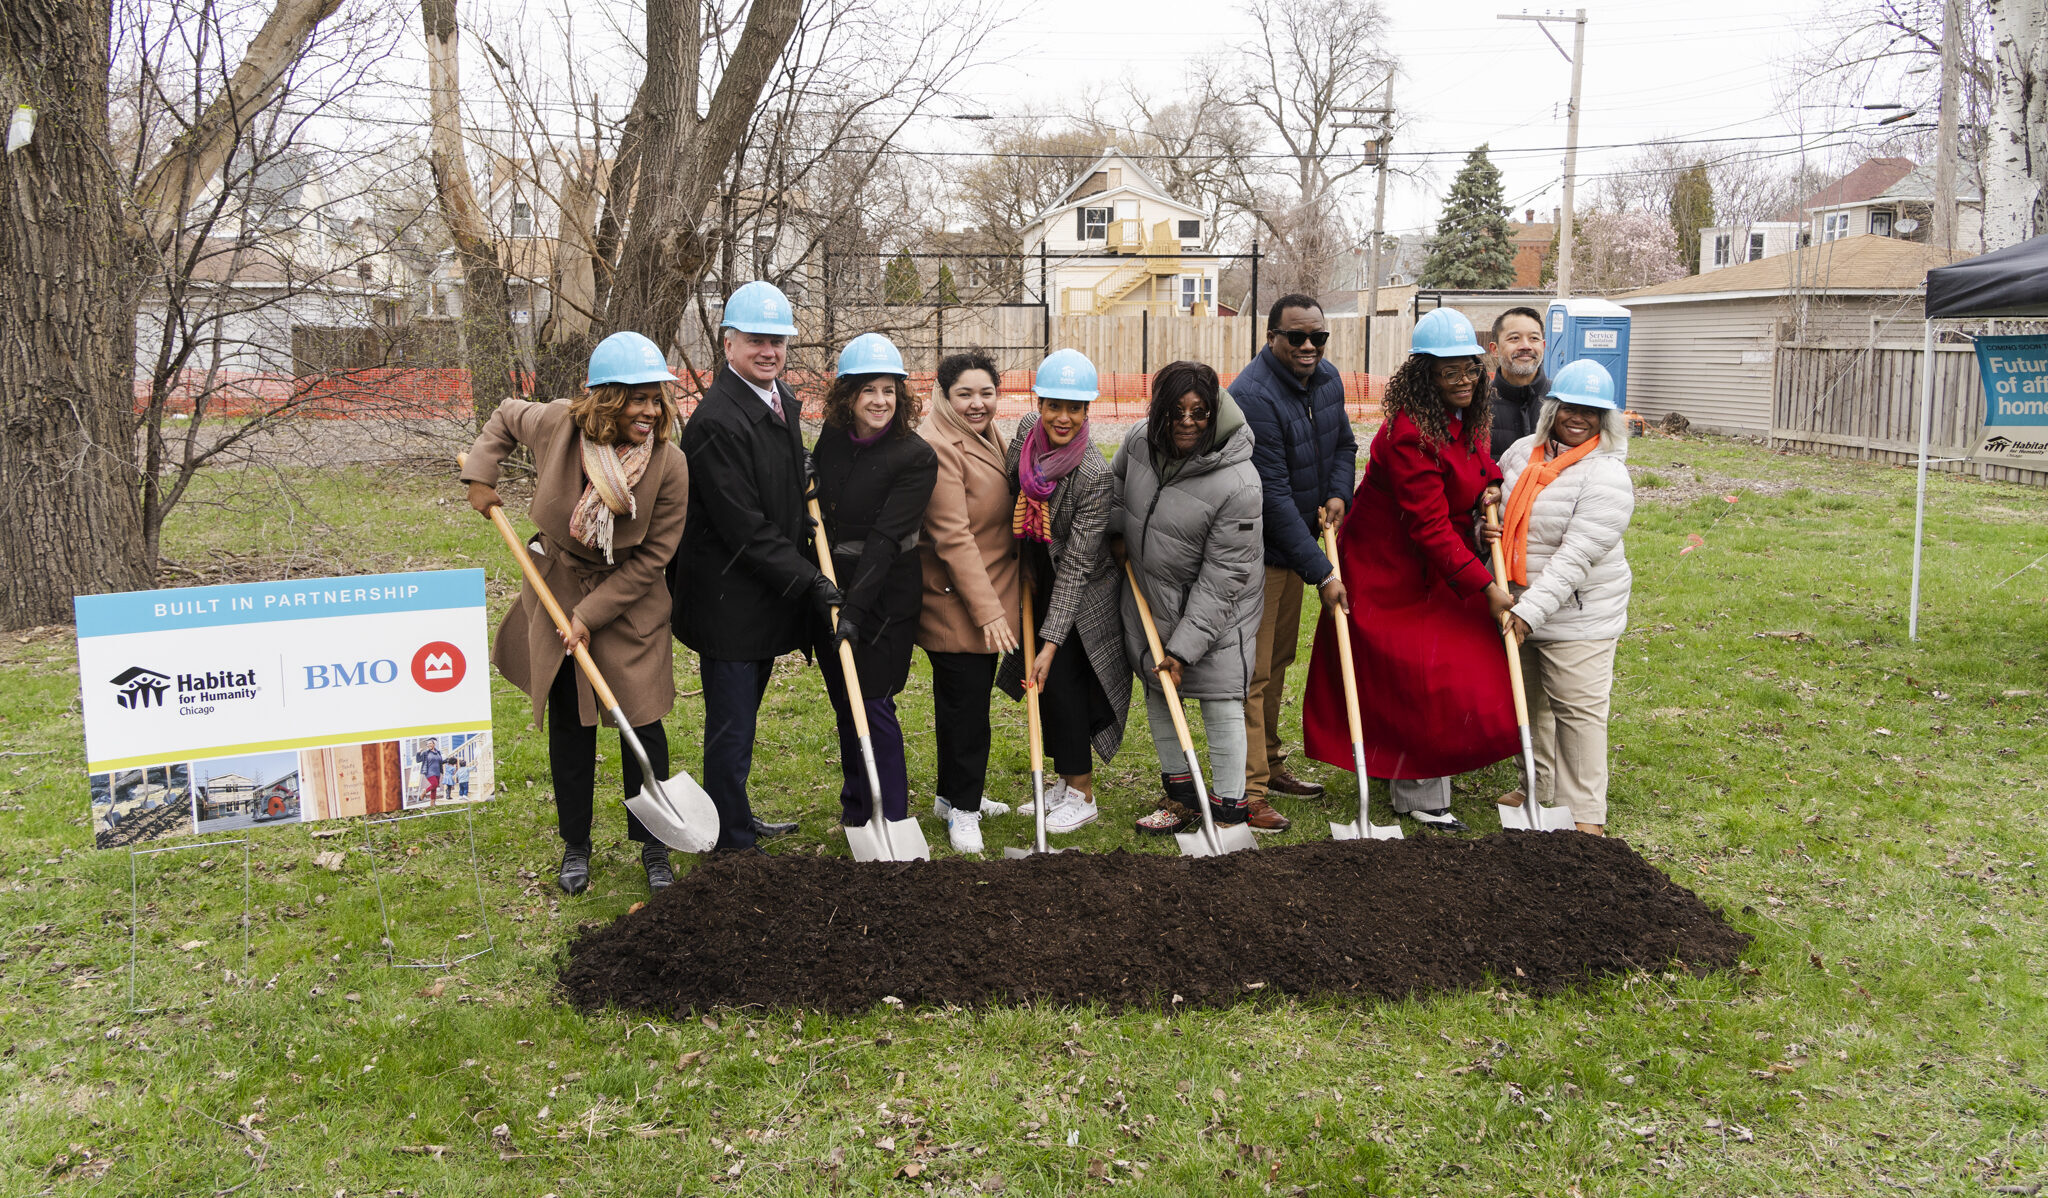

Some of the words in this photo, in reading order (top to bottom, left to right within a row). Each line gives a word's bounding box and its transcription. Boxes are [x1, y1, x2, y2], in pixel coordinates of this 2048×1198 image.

[1996, 376, 2018, 394] of
[154, 599, 220, 618] BUILT
[231, 596, 254, 612] IN
[264, 585, 420, 608] PARTNERSHIP
[177, 669, 256, 693] Habitat
[303, 659, 398, 691] BMO
[178, 694, 197, 705] for
[200, 688, 257, 703] Humanity
[179, 706, 215, 716] Chicago
